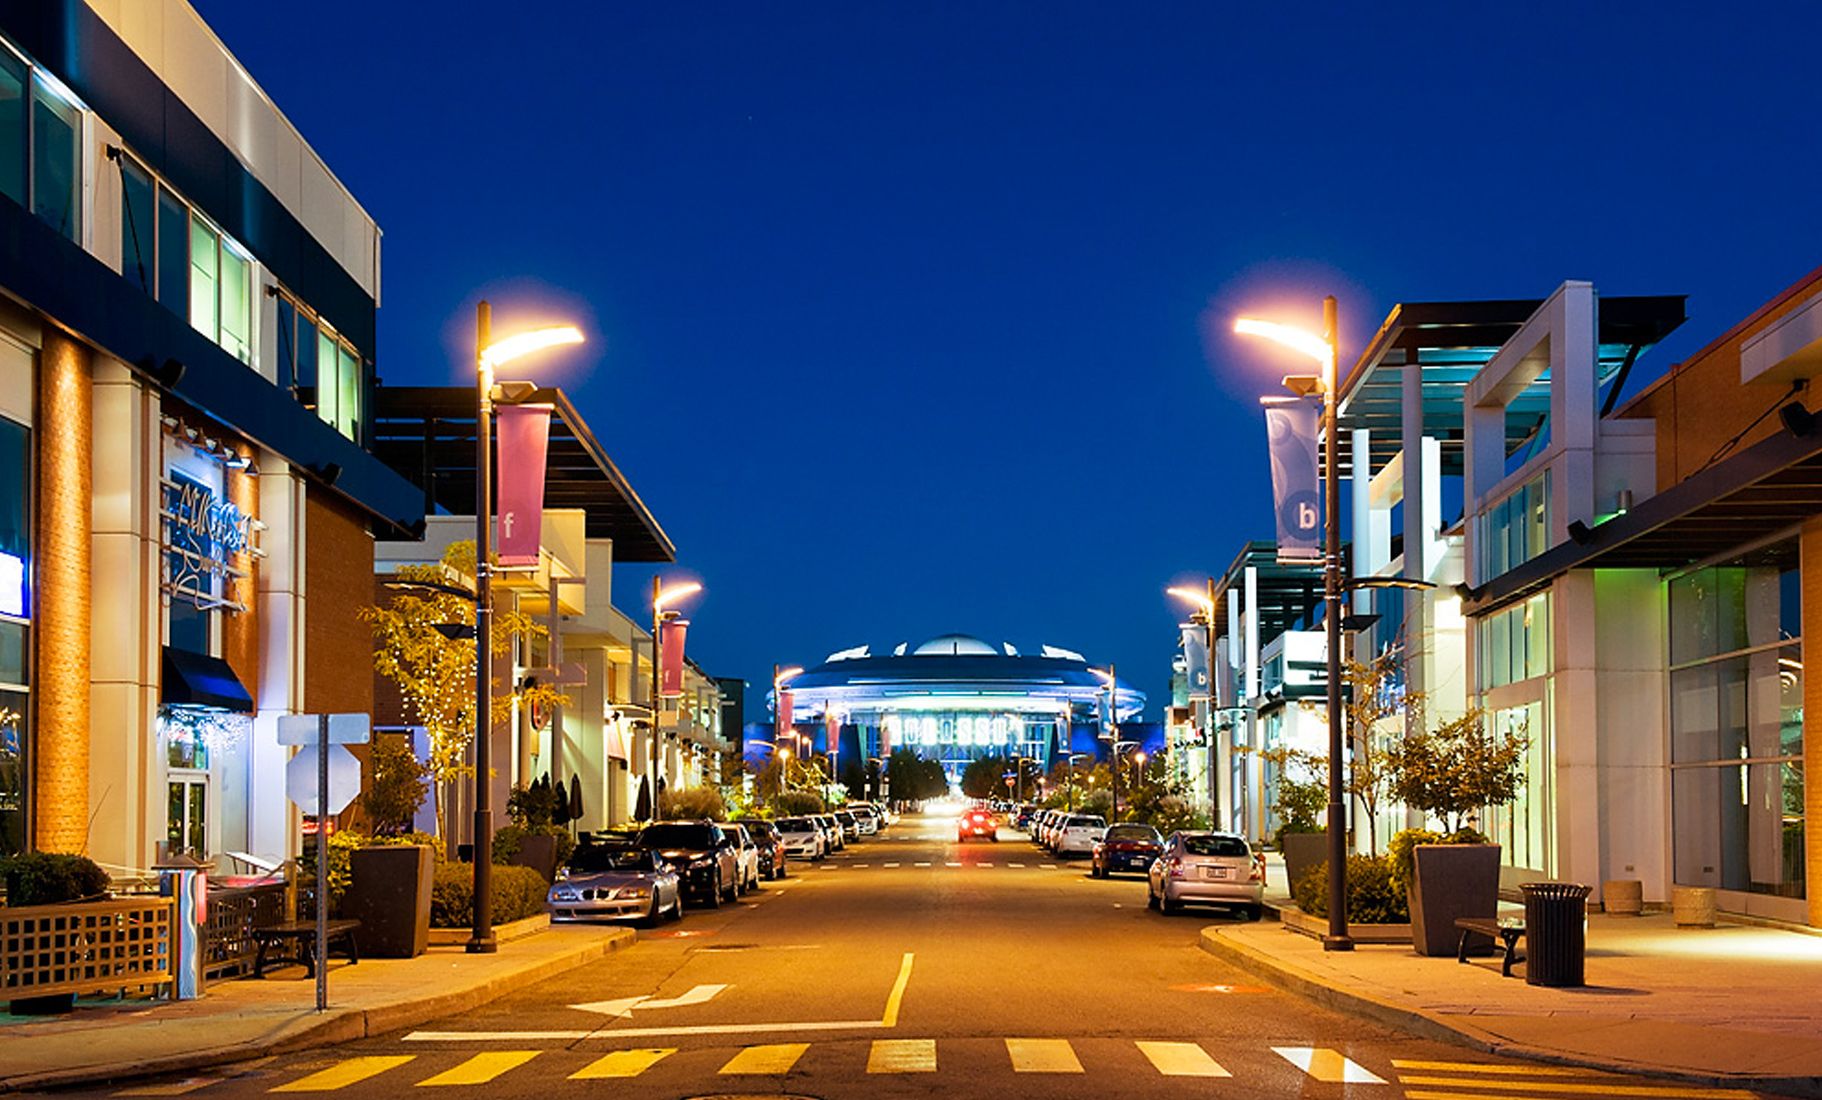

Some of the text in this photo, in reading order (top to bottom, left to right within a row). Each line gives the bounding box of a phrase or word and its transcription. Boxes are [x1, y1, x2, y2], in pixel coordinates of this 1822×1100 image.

[503, 511, 515, 539] f
[1299, 502, 1316, 529] b
[1197, 671, 1207, 685] b
